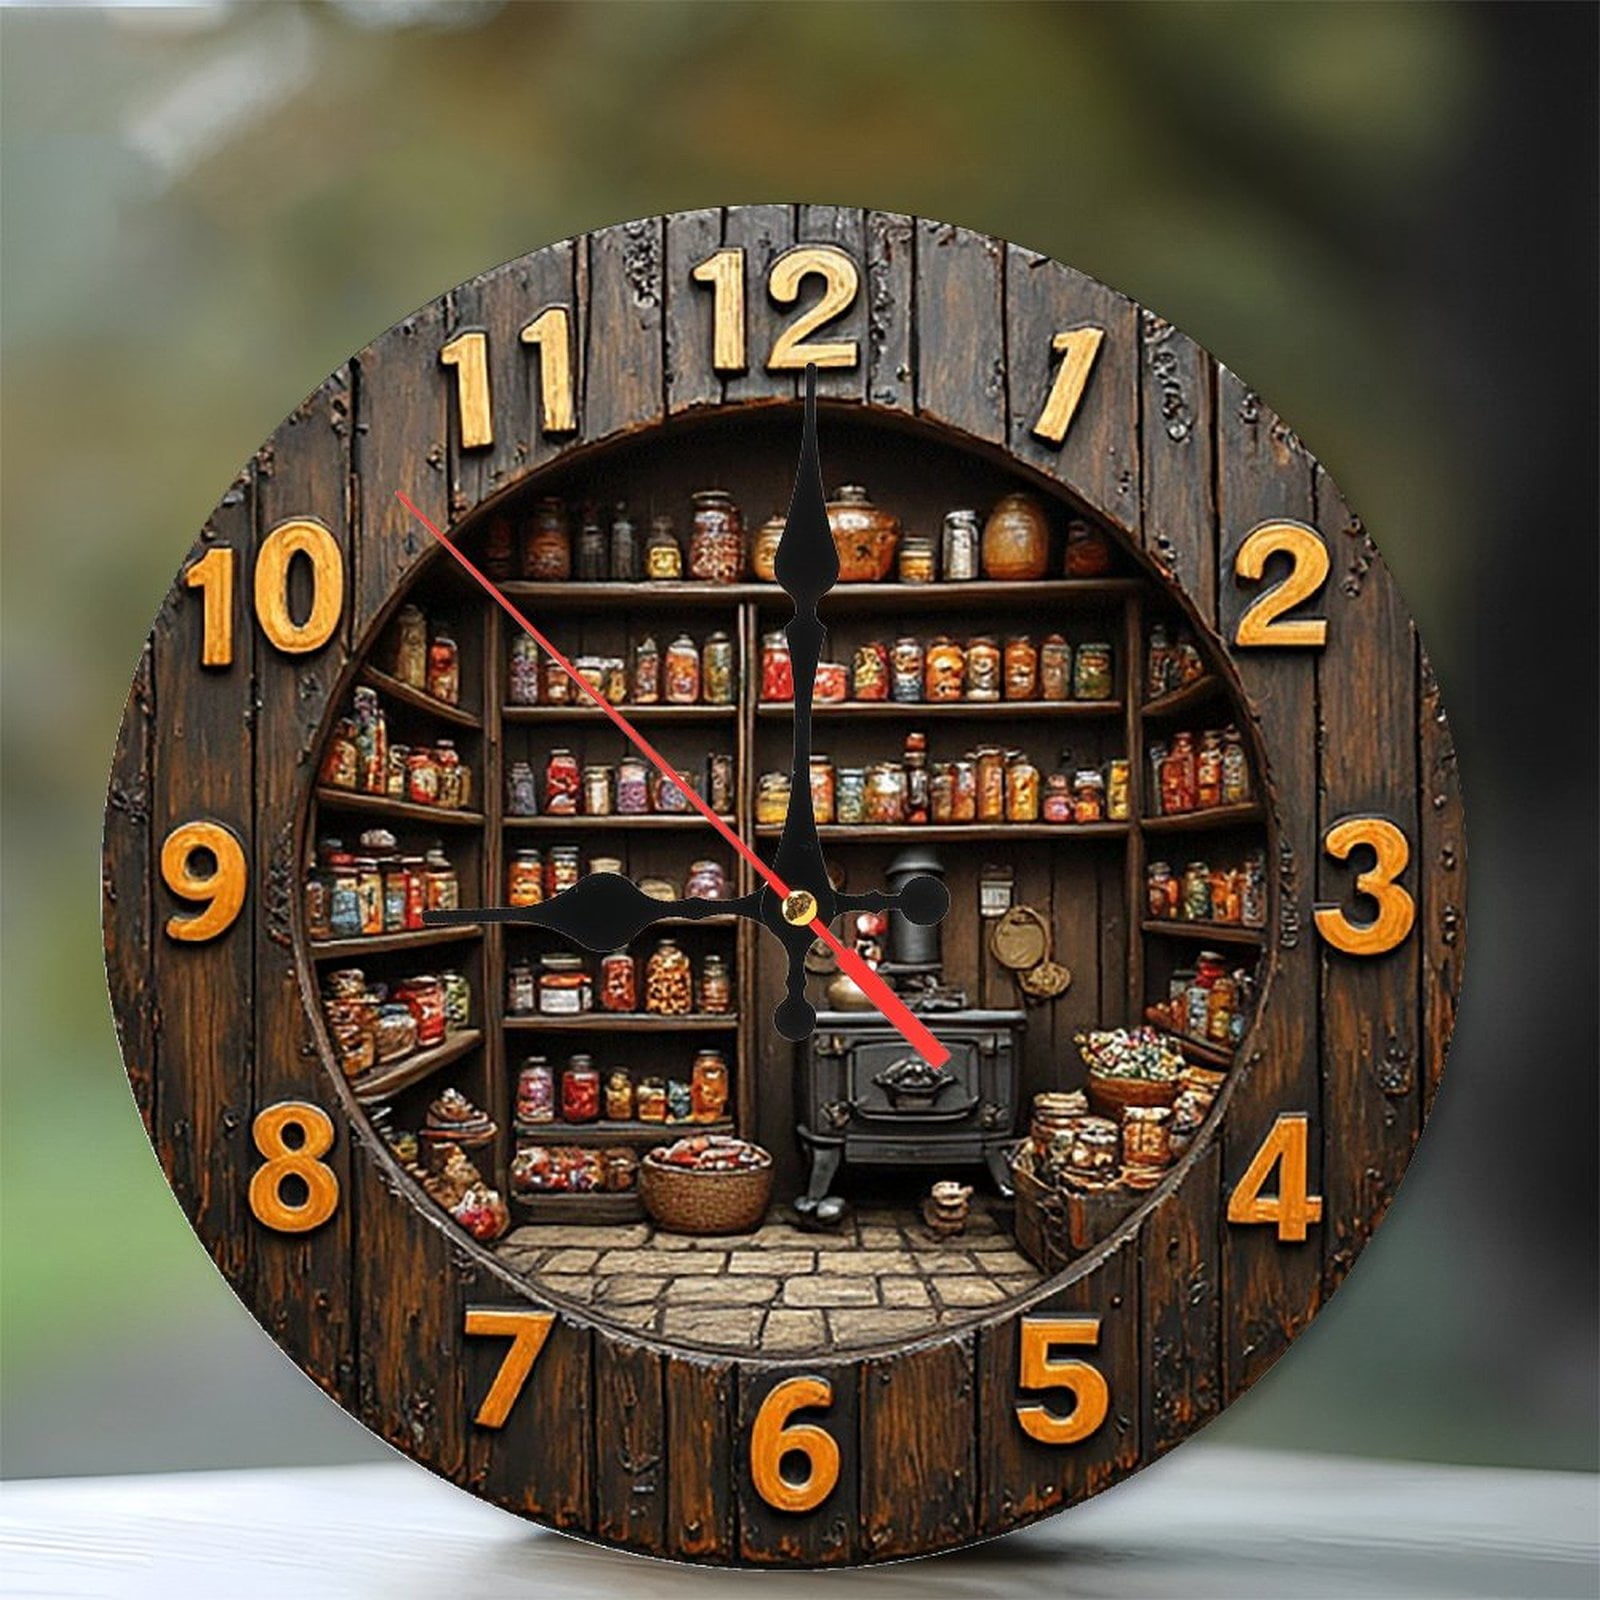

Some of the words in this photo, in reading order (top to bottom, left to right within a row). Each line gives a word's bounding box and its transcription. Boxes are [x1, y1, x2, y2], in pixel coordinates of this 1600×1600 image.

[693, 248, 859, 371] 12
[440, 308, 576, 449] 11
[1033, 326, 1104, 443] 1
[185, 517, 344, 668] 10
[1234, 520, 1331, 648] 2
[161, 821, 247, 942] 9
[1313, 817, 1415, 955] 3
[249, 1102, 338, 1232] 8
[1226, 1115, 1322, 1241] 4
[465, 1310, 556, 1427] 7
[1016, 1318, 1109, 1444] 5
[750, 1375, 840, 1512] 6
